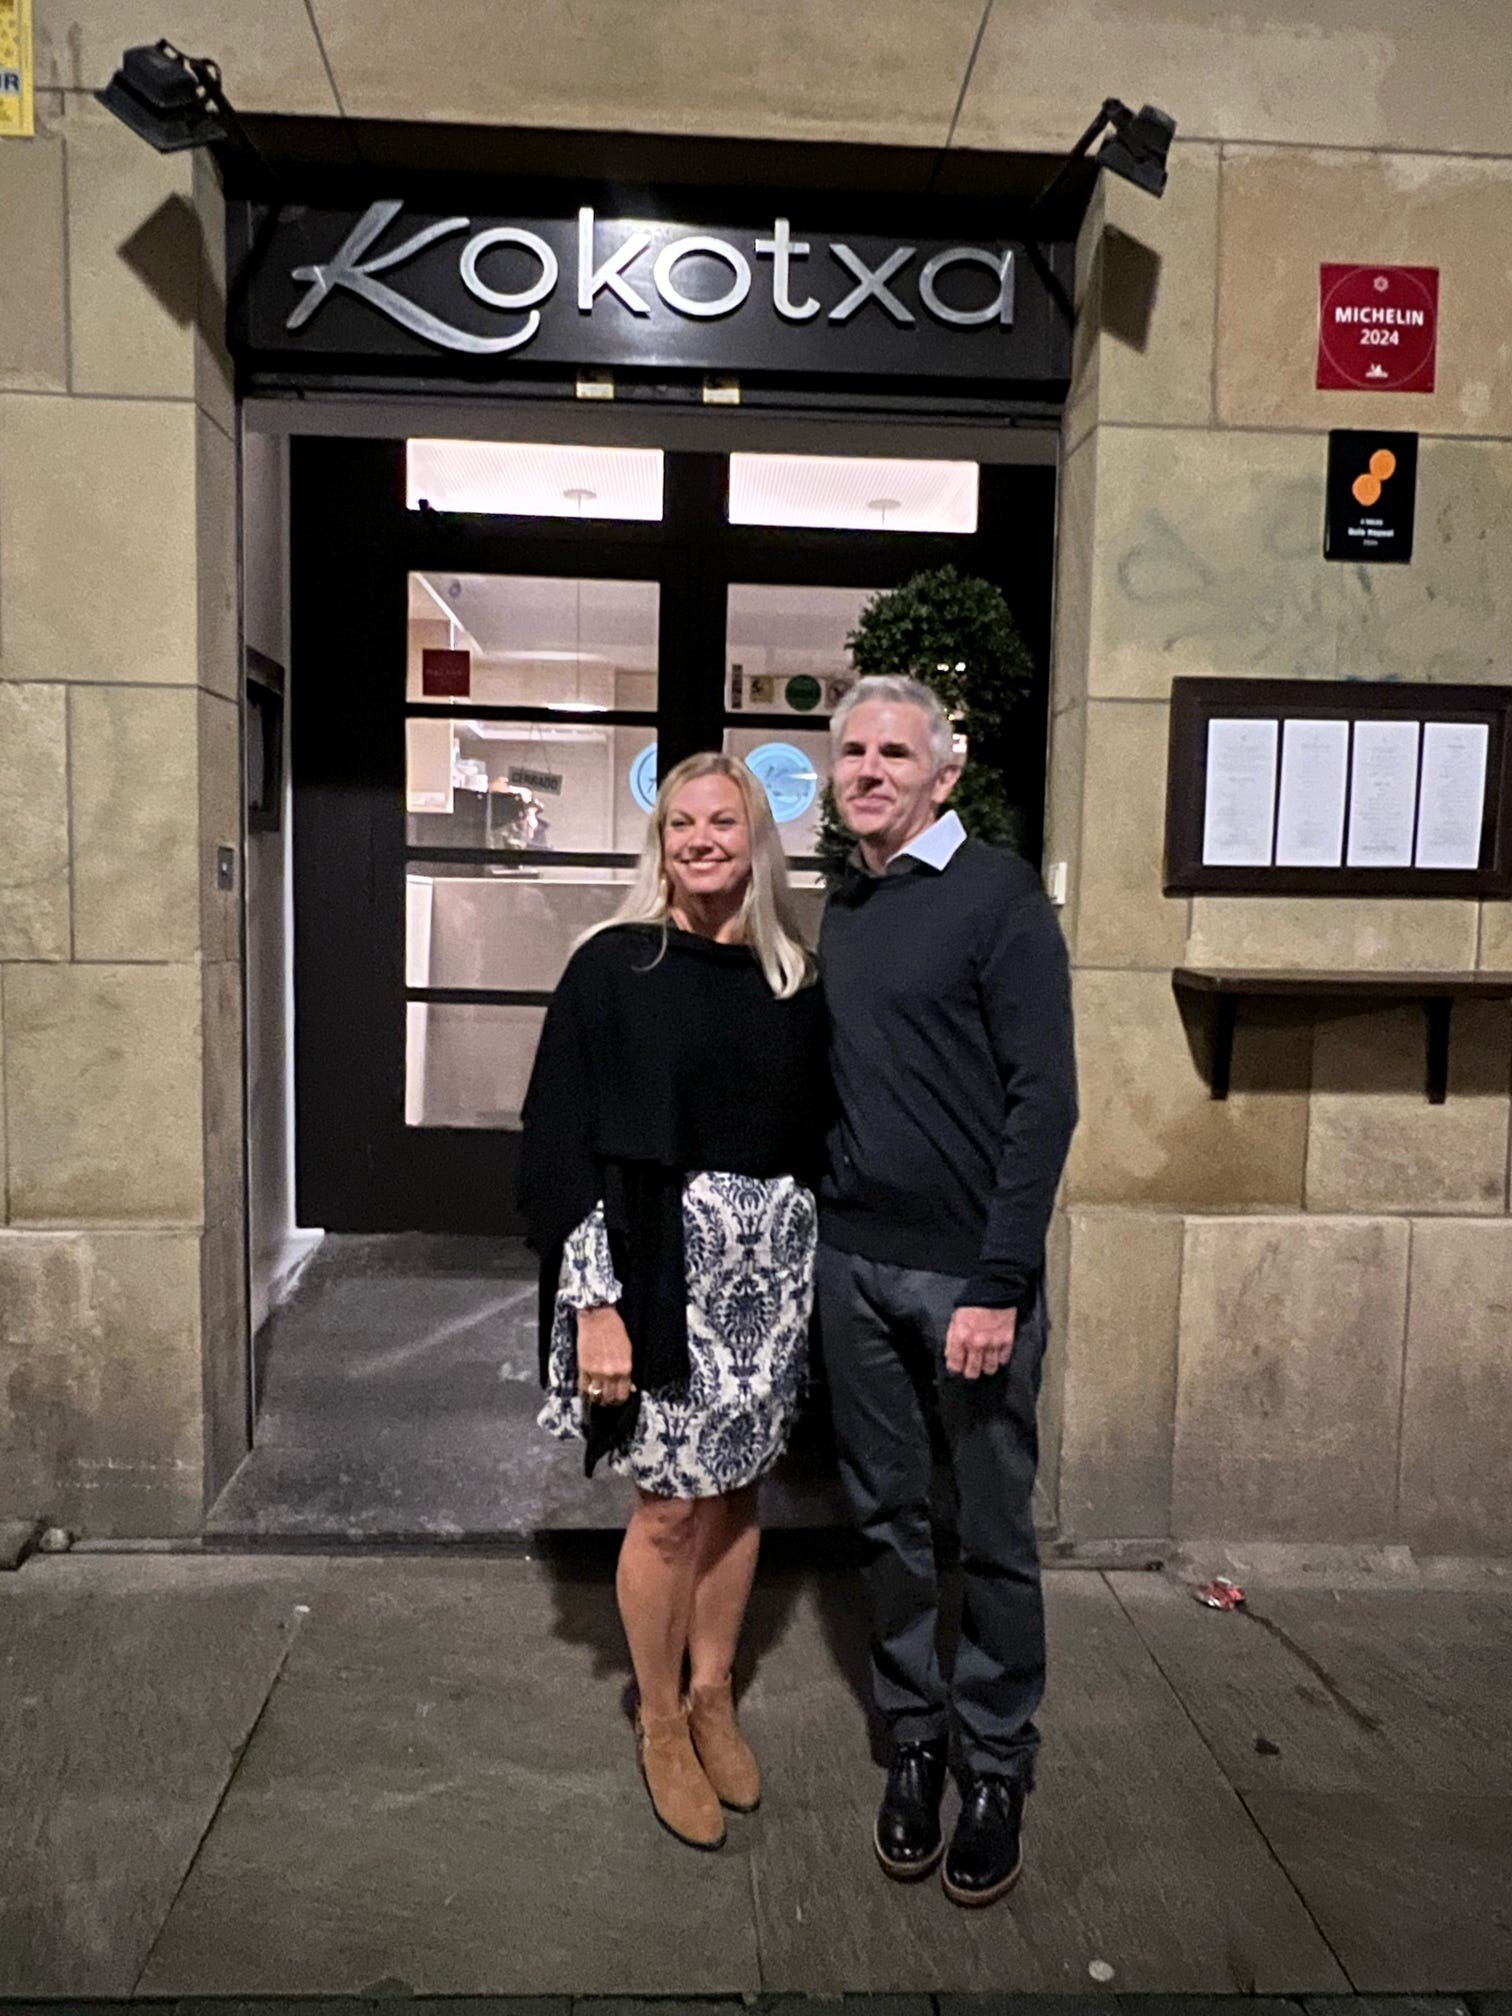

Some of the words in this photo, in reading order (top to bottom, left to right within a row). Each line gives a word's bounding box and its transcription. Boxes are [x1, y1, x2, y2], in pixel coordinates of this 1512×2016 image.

[285, 198, 1015, 353] Kokotxa
[1335, 307, 1424, 326] MICHELIN
[1360, 329, 1399, 346] 2024
